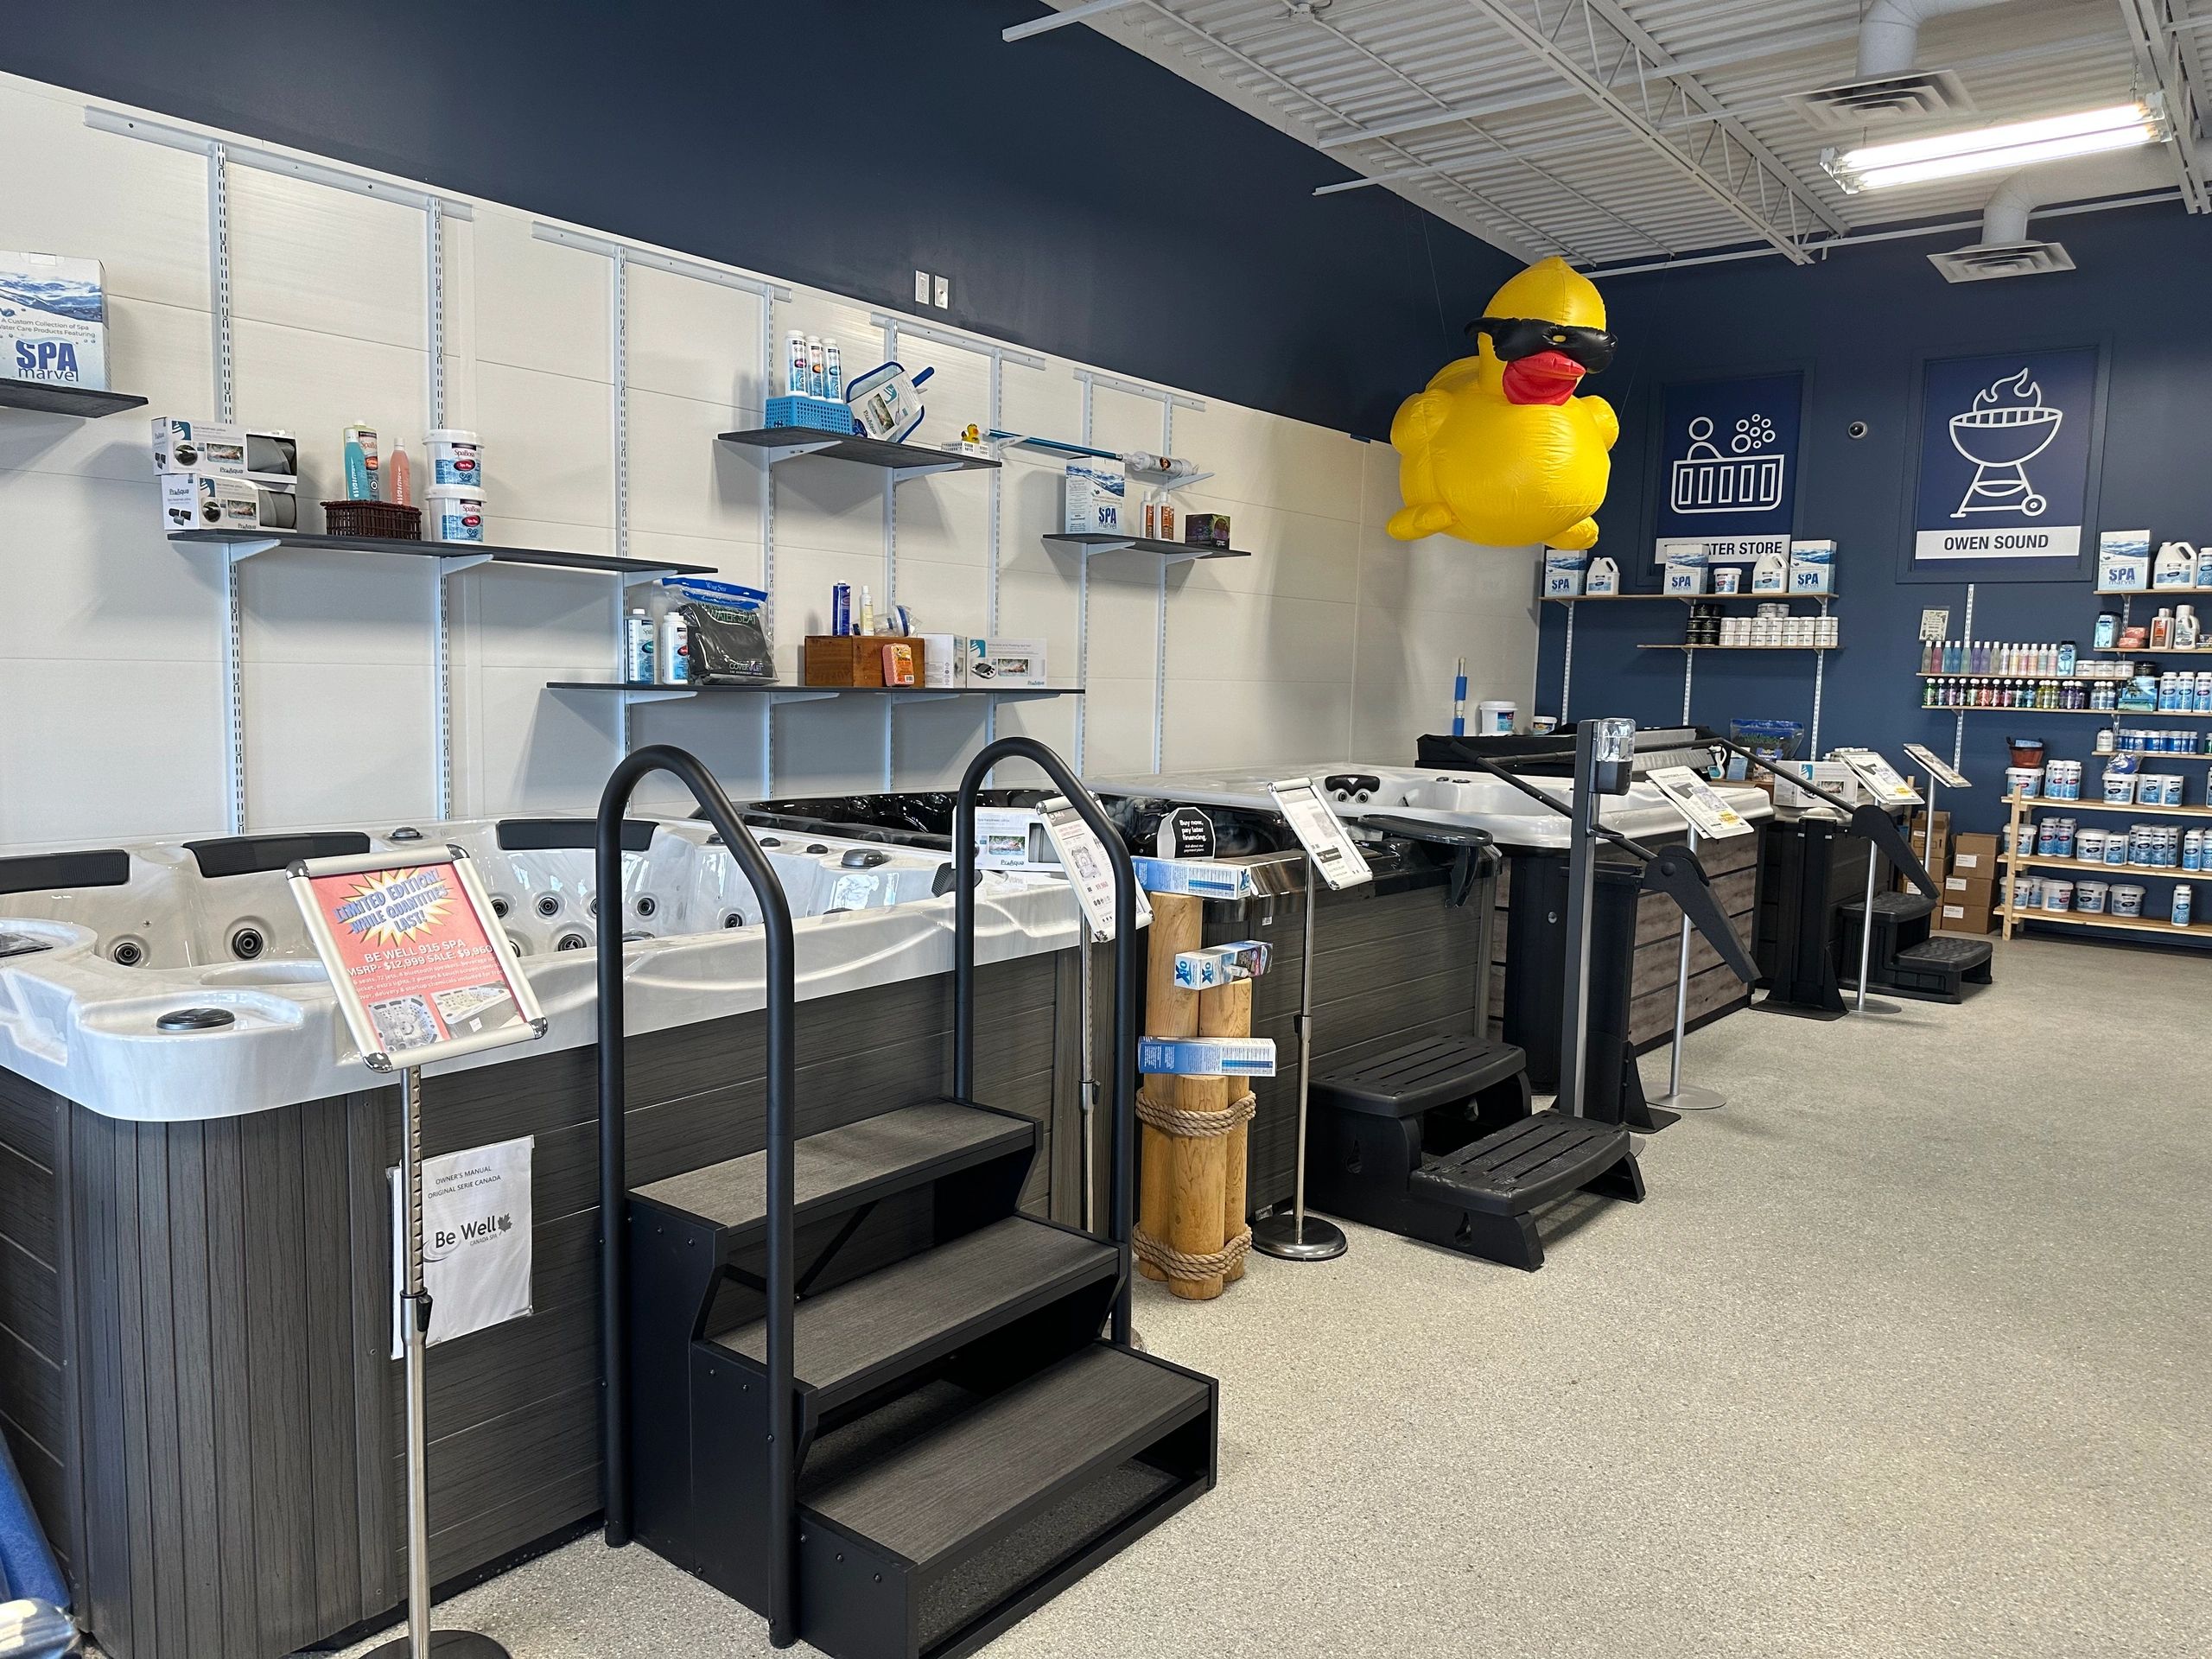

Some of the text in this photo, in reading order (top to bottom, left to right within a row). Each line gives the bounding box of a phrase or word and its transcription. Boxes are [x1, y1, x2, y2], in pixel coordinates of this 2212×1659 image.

[34, 327, 63, 335] Products
[65, 329, 95, 338] Featuring
[16, 340, 78, 372] SPA
[18, 367, 79, 382] marvel
[1098, 506, 1117, 524] SPA
[1739, 542, 1783, 555] STORE
[1944, 534, 2049, 550] OWEN SOUND
[1672, 575, 1691, 588] SPA
[1797, 573, 1819, 585] SPA
[2108, 567, 2136, 582] SPA
[1552, 579, 1570, 589] SPA
[333, 868, 442, 924] LIMITED EDITION!
[349, 884, 449, 934] WHILE QUANTITIES
[393, 910, 428, 932] LAST!
[364, 938, 467, 963] BE WELL 915 SPA
[383, 957, 426, 971] $12,999
[427, 953, 456, 963] SALE:
[435, 1166, 492, 1185] OWNER'S MANUAL
[428, 1175, 501, 1199] ORIGINAL SERIE CANADA
[435, 1215, 496, 1248] Be Well
[469, 1236, 489, 1246] CANADA
